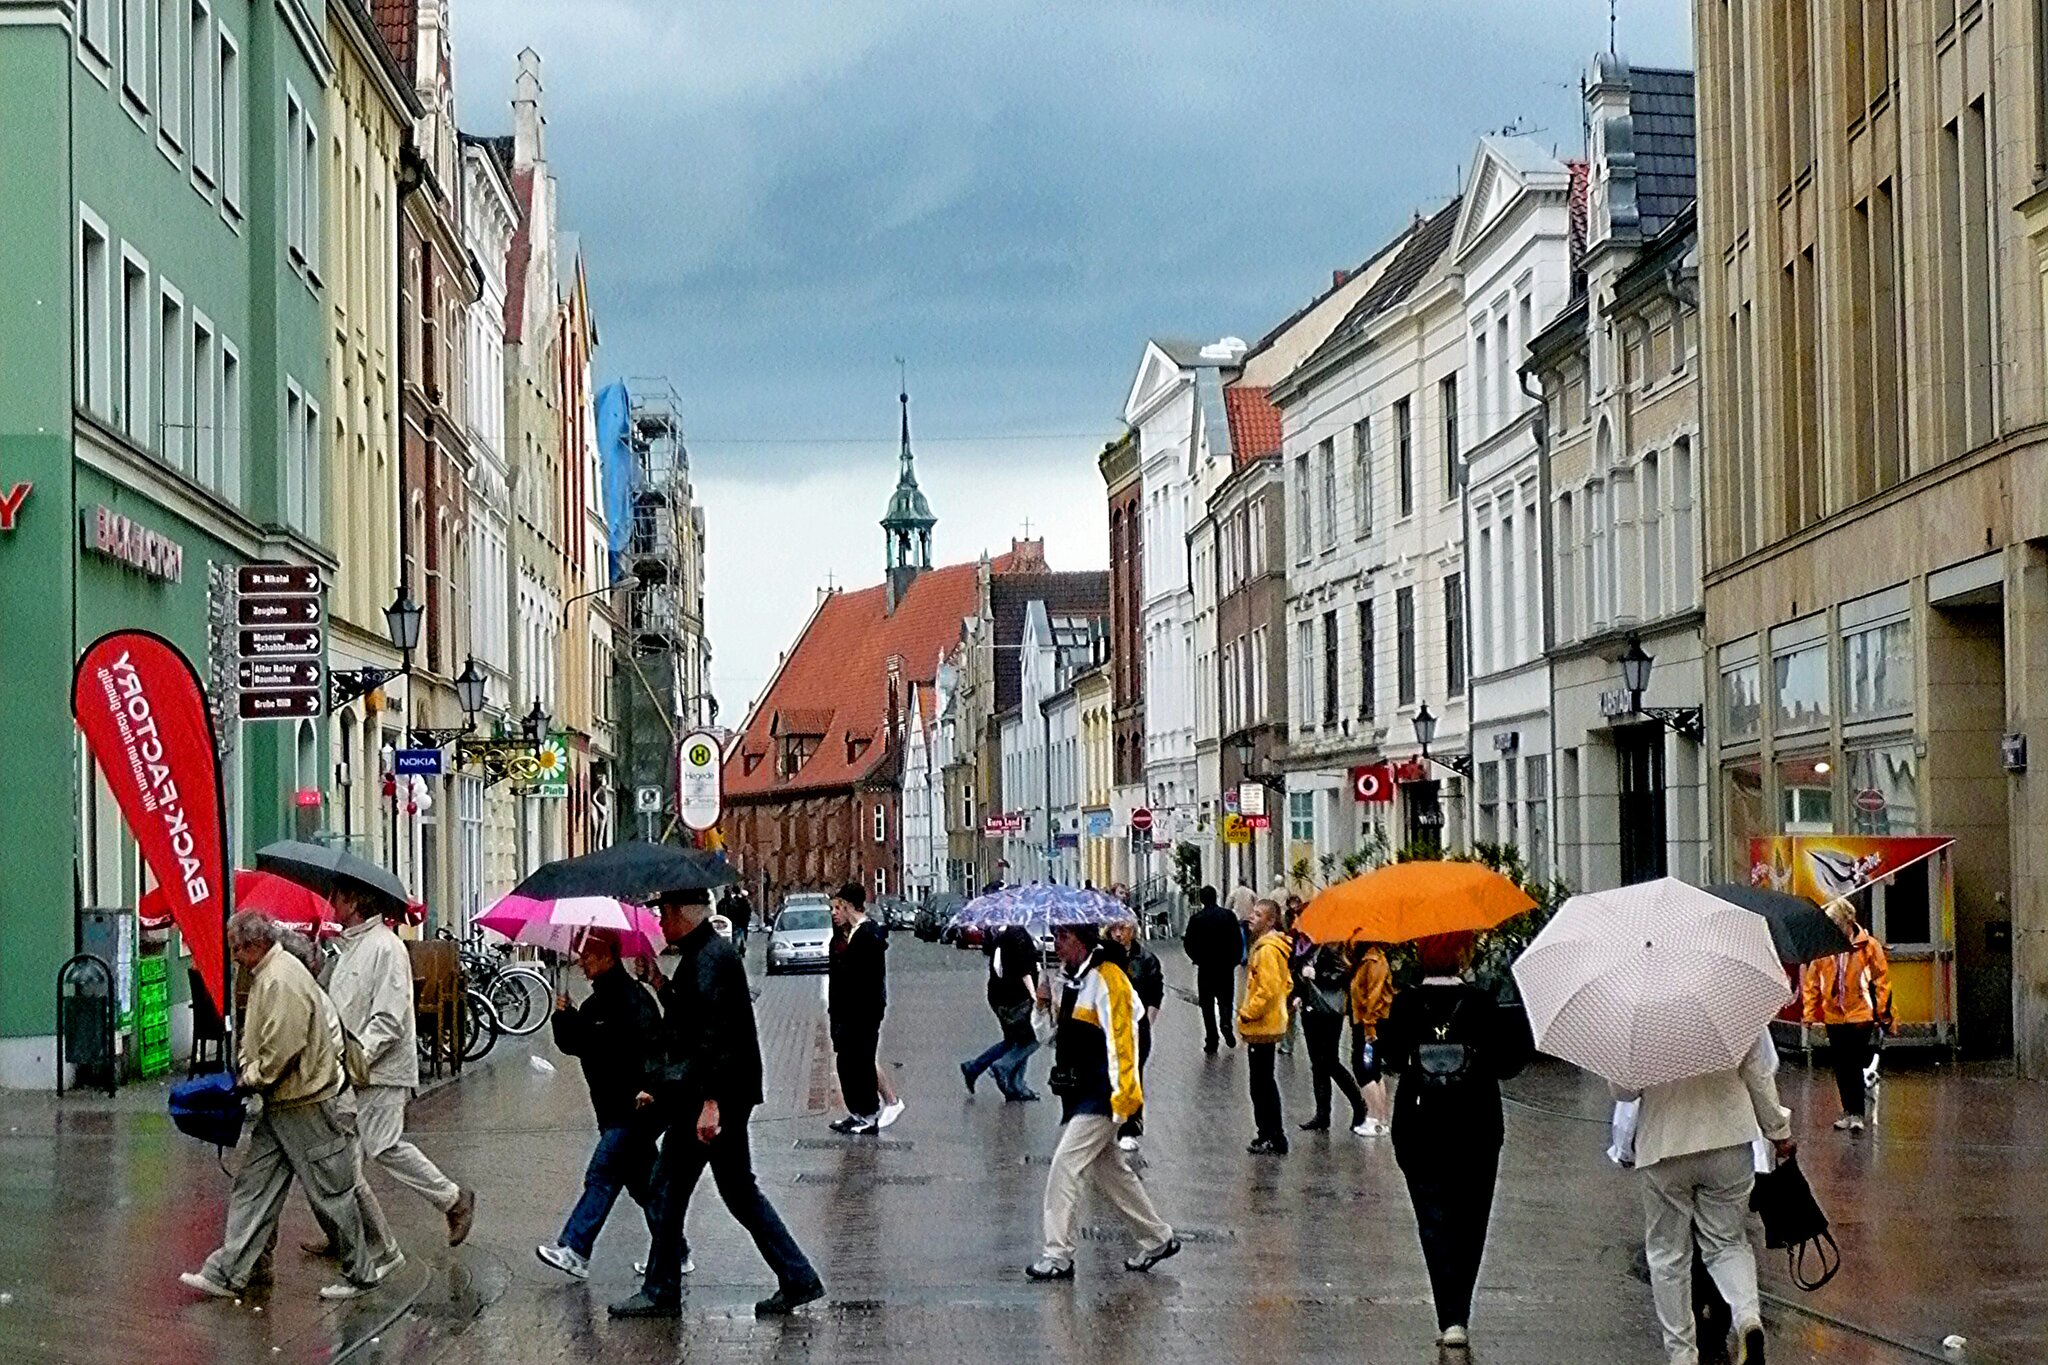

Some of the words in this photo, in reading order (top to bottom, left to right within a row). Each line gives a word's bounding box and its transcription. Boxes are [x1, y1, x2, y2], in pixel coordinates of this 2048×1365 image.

[253, 575, 263, 583] St.
[264, 575, 289, 583] Nikolai
[253, 606, 288, 616] Zeughaus
[240, 669, 251, 677] WC
[255, 665, 271, 673] Alter
[254, 674, 291, 683] Baumhaus
[254, 699, 276, 708] Grube
[695, 749, 705, 761] H
[399, 757, 437, 766] NOKIA
[987, 816, 1003, 826] Euro
[1004, 816, 1020, 826] Land
[1226, 830, 1249, 838] LOTTO
